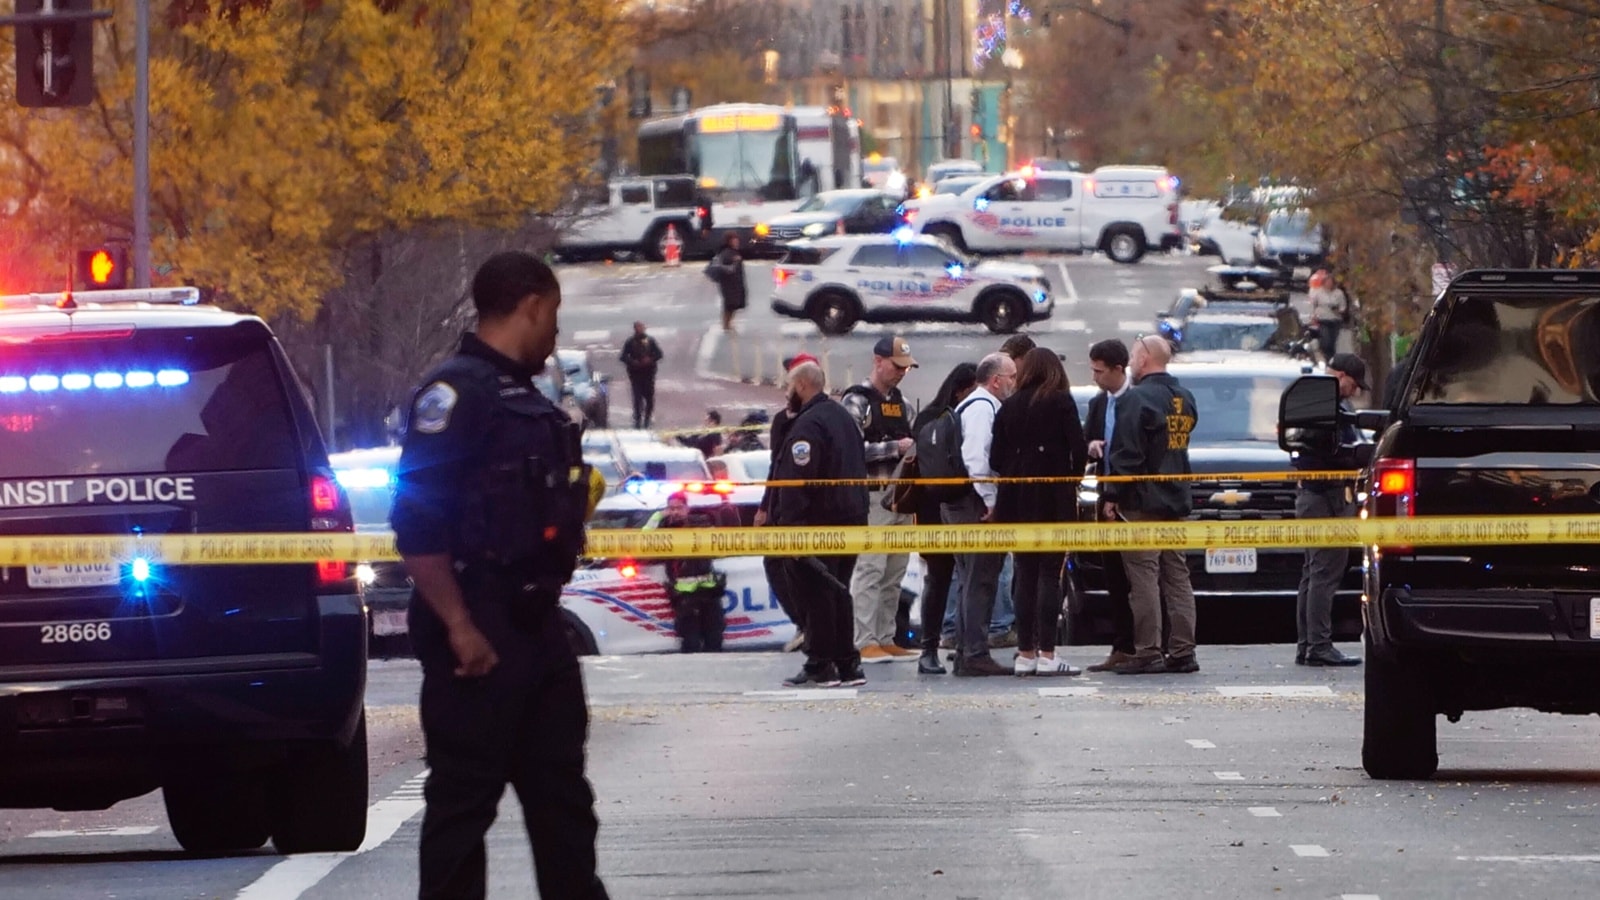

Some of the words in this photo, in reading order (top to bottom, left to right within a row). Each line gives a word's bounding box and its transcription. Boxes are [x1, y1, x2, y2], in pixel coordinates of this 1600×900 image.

[1001, 216, 1067, 227] POLICE
[857, 279, 932, 292] POLICE
[86, 477, 196, 503] POLICE
[711, 533, 745, 551] POLICE
[750, 532, 769, 551] LINE
[774, 532, 786, 550] DO
[789, 532, 809, 550] NOT
[813, 531, 846, 550] CROSS
[882, 532, 917, 549] POLICE
[919, 531, 941, 549] LINE
[944, 530, 957, 548] DO
[961, 530, 981, 548] NOT
[984, 529, 1017, 548] CROSS
[1052, 528, 1085, 546] POLICE
[1089, 528, 1111, 546] LINE
[1114, 527, 1128, 545] DO
[1131, 527, 1150, 545] NOT
[1154, 527, 1188, 545] CROSS
[1224, 526, 1259, 544] POLICE
[1263, 526, 1286, 543] LINE
[1325, 525, 1360, 542] CROSS
[1396, 522, 1430, 541] POLICE
[1475, 521, 1494, 540] NOT
[1497, 521, 1529, 539] CROSS
[201, 539, 233, 559] POLICE
[237, 539, 258, 558] LINE
[261, 538, 275, 558] DO
[279, 538, 298, 558] NOT
[302, 538, 334, 557] CROSS
[602, 534, 614, 553] DO
[618, 534, 637, 553] NOT
[640, 533, 673, 552] CROSS
[41, 623, 112, 643] 28666
